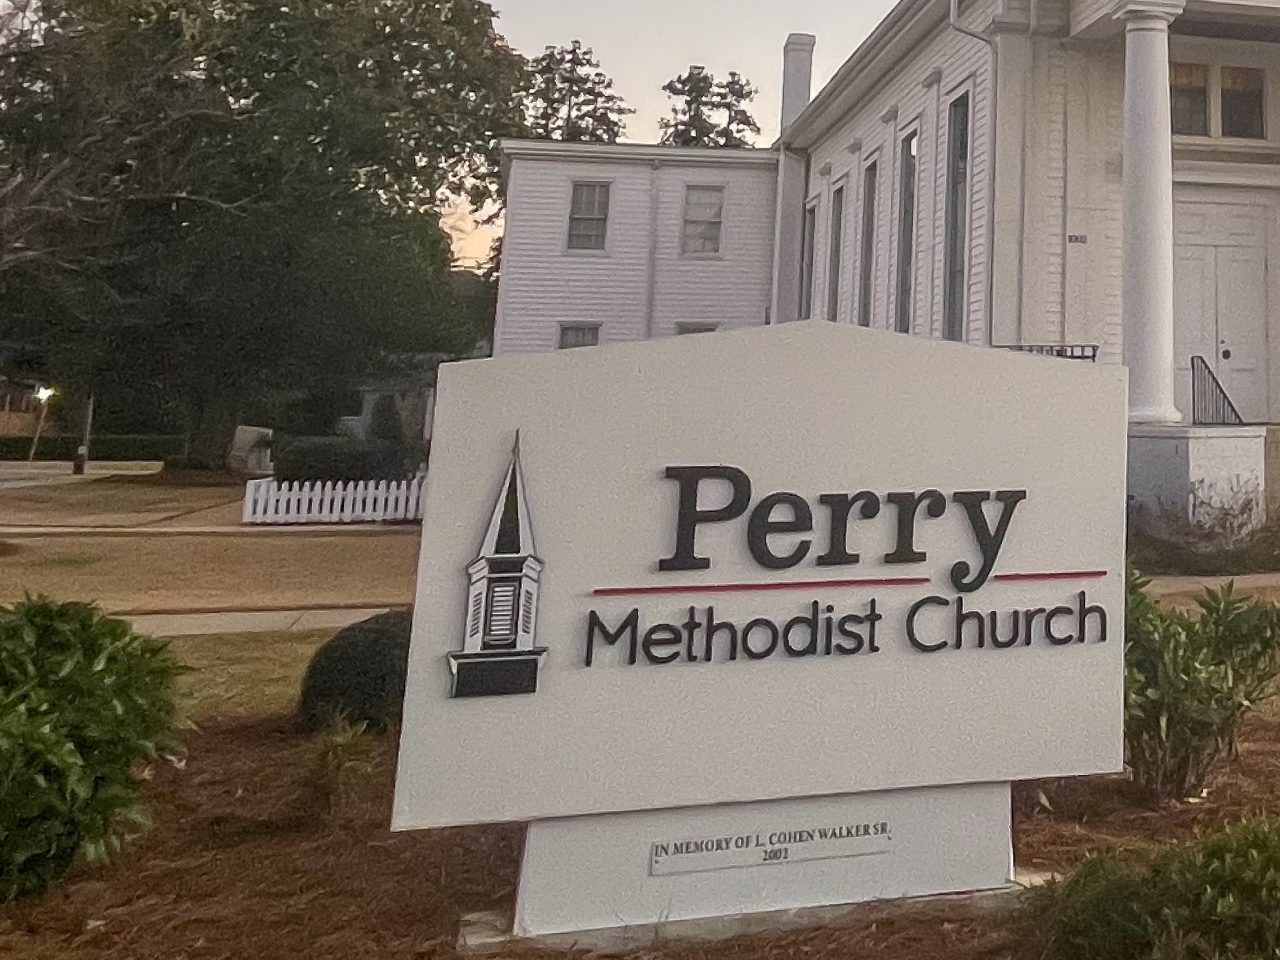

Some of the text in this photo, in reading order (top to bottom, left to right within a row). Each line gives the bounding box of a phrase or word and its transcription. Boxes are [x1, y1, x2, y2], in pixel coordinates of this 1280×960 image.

[657, 465, 1027, 594] Perry
[583, 590, 1108, 668] Methodist Church
[654, 842, 670, 858] IN
[672, 836, 733, 856] MEMORY
[734, 834, 753, 849] OF
[768, 828, 816, 846] COHEN
[817, 823, 872, 841] WALKER
